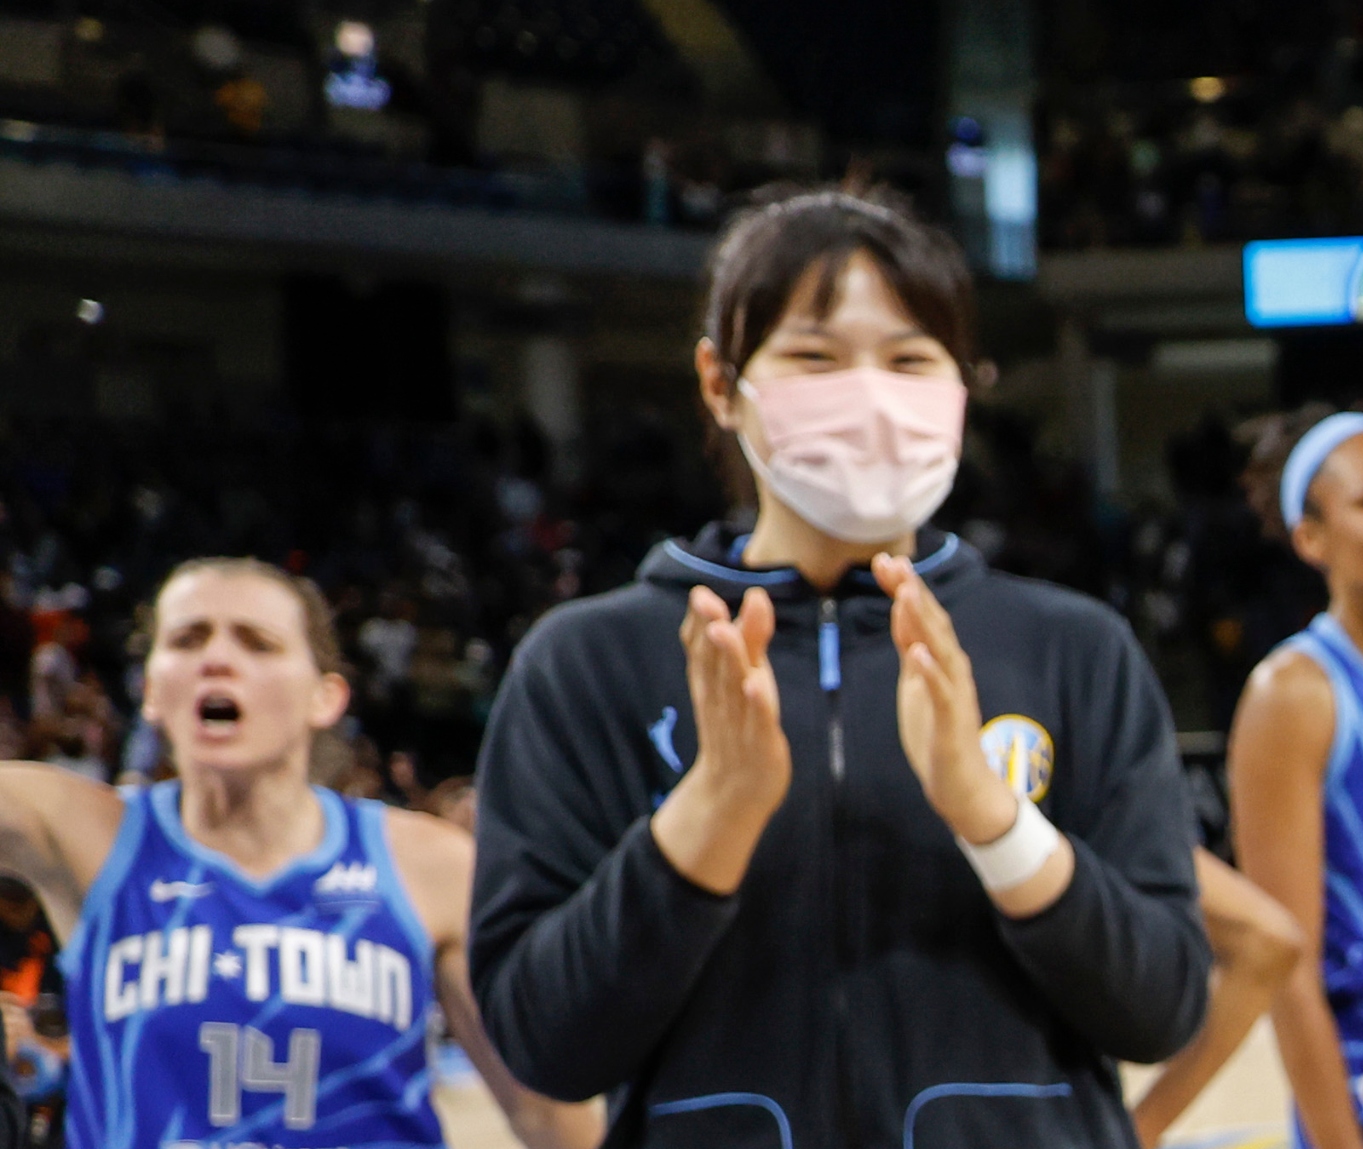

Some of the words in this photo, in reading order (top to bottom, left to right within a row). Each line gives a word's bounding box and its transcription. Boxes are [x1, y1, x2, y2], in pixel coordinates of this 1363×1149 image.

[104, 925, 212, 1023] CHI
[233, 924, 412, 1031] TOWN
[199, 1021, 322, 1130] 14
